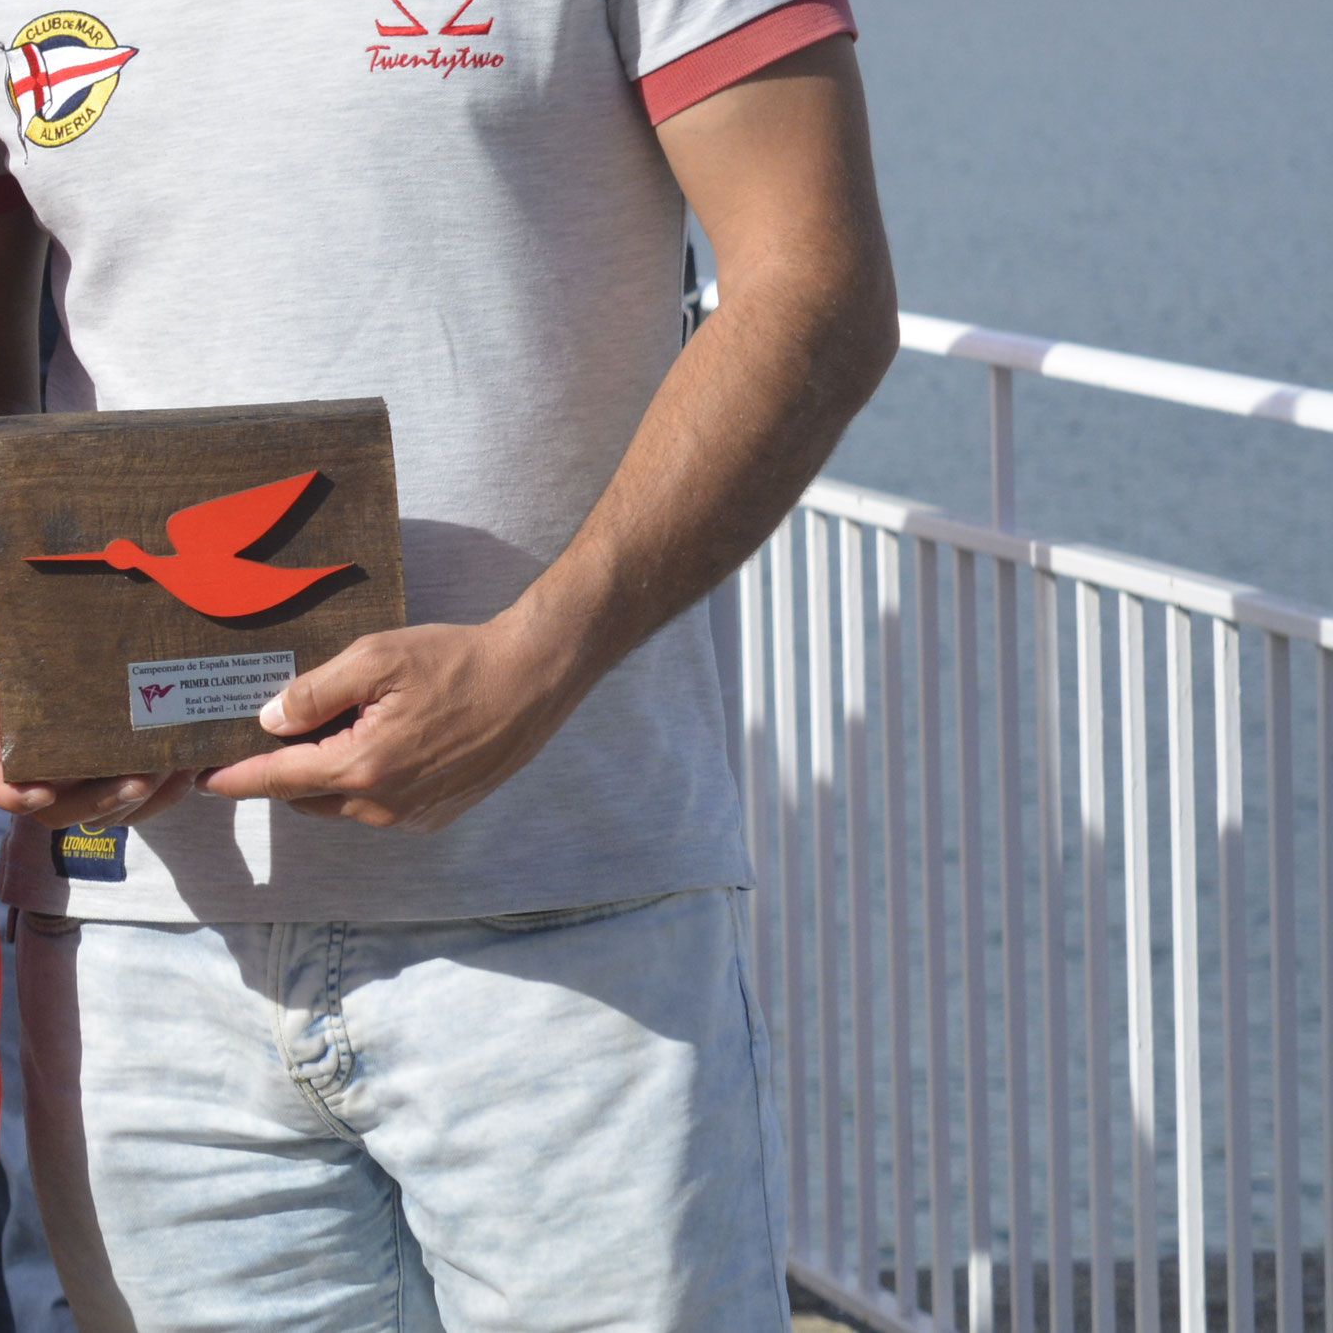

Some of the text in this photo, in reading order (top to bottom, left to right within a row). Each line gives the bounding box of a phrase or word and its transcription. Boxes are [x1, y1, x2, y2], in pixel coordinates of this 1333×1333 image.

[25, 17, 62, 41] CLUB
[74, 18, 104, 46] MAR
[365, 45, 505, 80] Twentytwo
[40, 107, 97, 141] ALMERIA
[132, 653, 292, 676] Campeonato de España Máster SNIPE
[179, 671, 291, 690] PRIMER CLASIFICADO JUNIOR
[185, 697, 202, 705] Real
[203, 695, 221, 704] Club
[223, 693, 252, 702] Náutico
[186, 707, 195, 715] 28
[197, 706, 206, 714] de
[207, 705, 224, 713] abril
[59, 835, 117, 852] LTONADOCK
